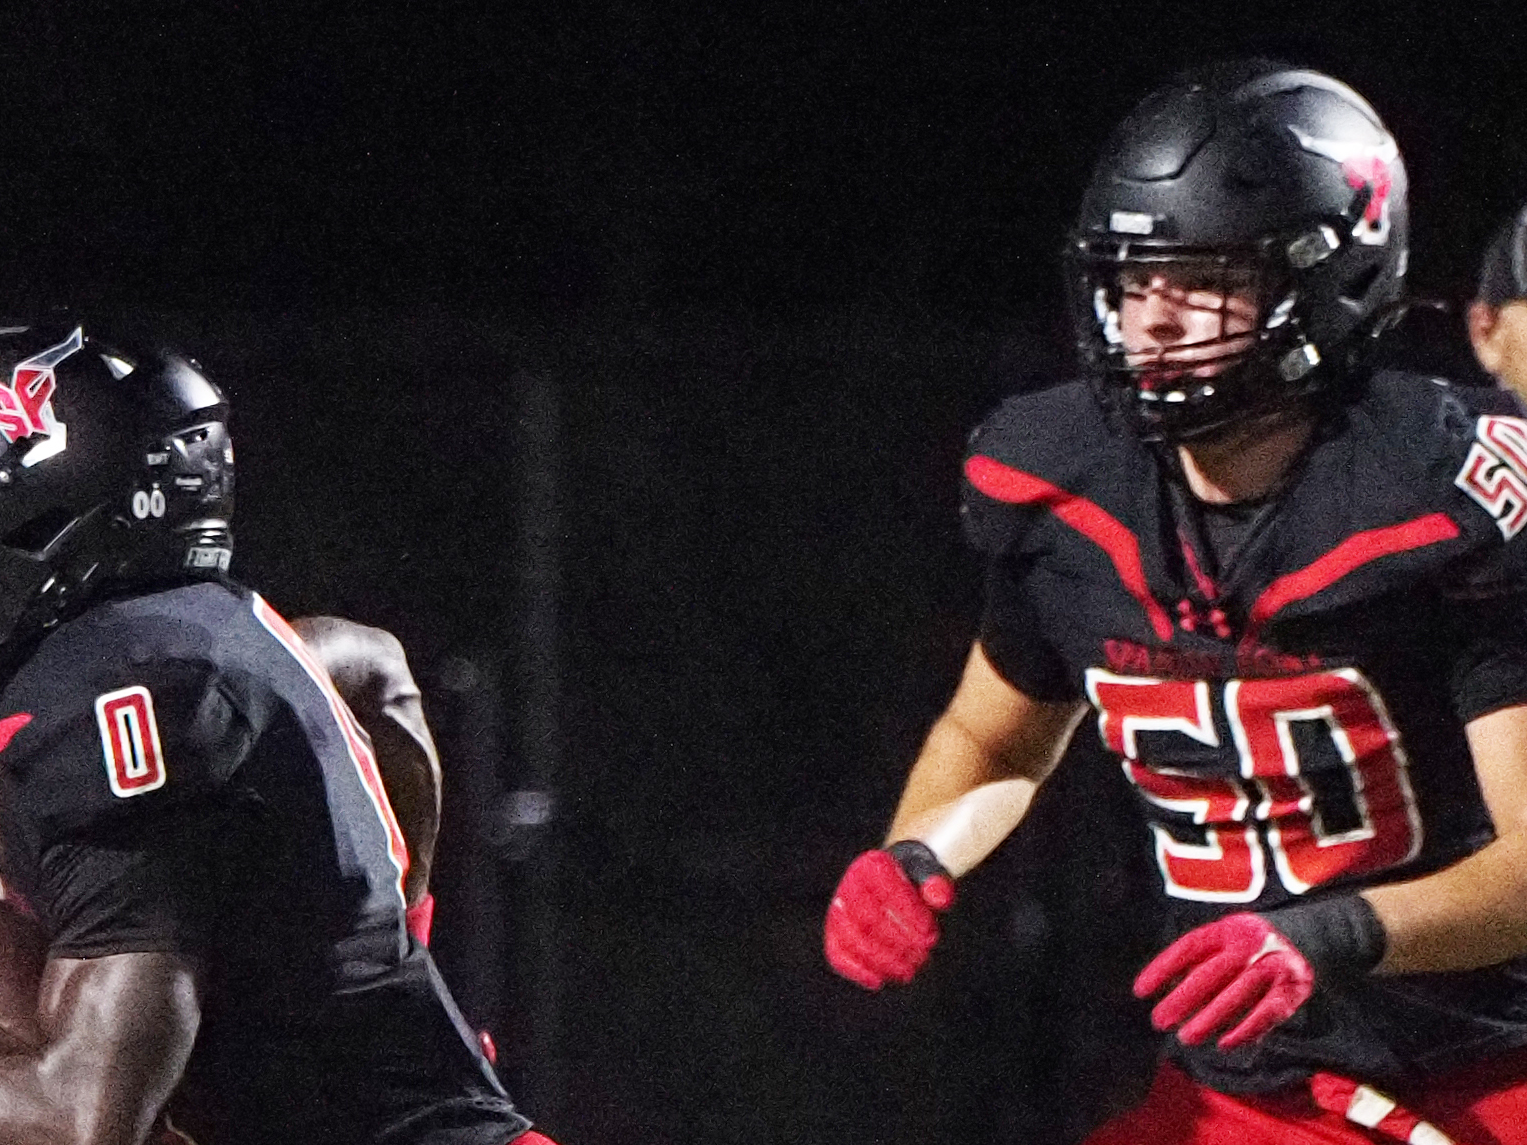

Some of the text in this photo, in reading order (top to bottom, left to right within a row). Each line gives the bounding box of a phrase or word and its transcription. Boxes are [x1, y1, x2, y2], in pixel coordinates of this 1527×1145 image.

[133, 490, 166, 519] 00
[95, 685, 167, 798] 0
[1084, 666, 1424, 904] 50
